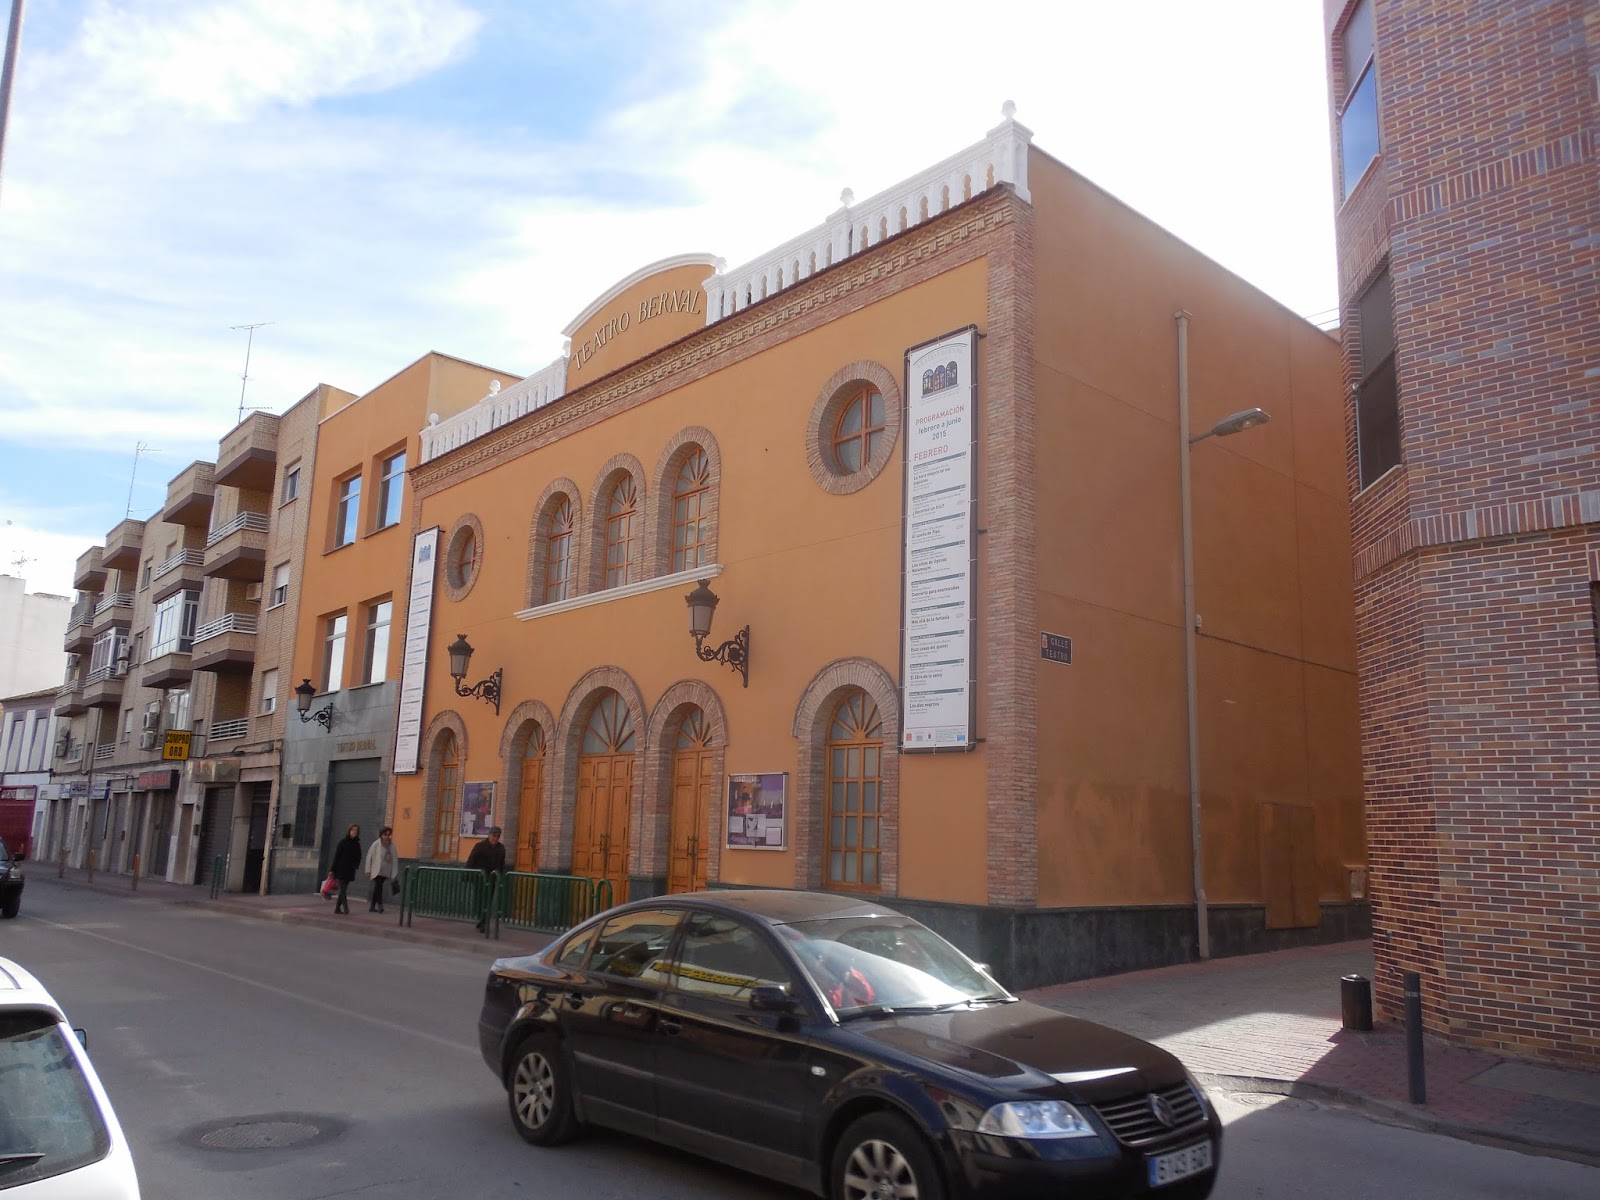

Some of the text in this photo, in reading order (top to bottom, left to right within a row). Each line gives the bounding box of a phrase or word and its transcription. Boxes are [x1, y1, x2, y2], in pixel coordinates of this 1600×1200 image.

[573, 289, 701, 370] TEATRO BERNAL
[915, 405, 965, 426] PROGRAMACIÓN
[918, 423, 940, 435] febrero
[946, 417, 962, 429] junio
[932, 430, 947, 441] 2015
[914, 445, 949, 461] FEBRERO
[1050, 638, 1068, 648] CALLE
[166, 732, 190, 744] COMPRO
[170, 746, 182, 756] ORO
